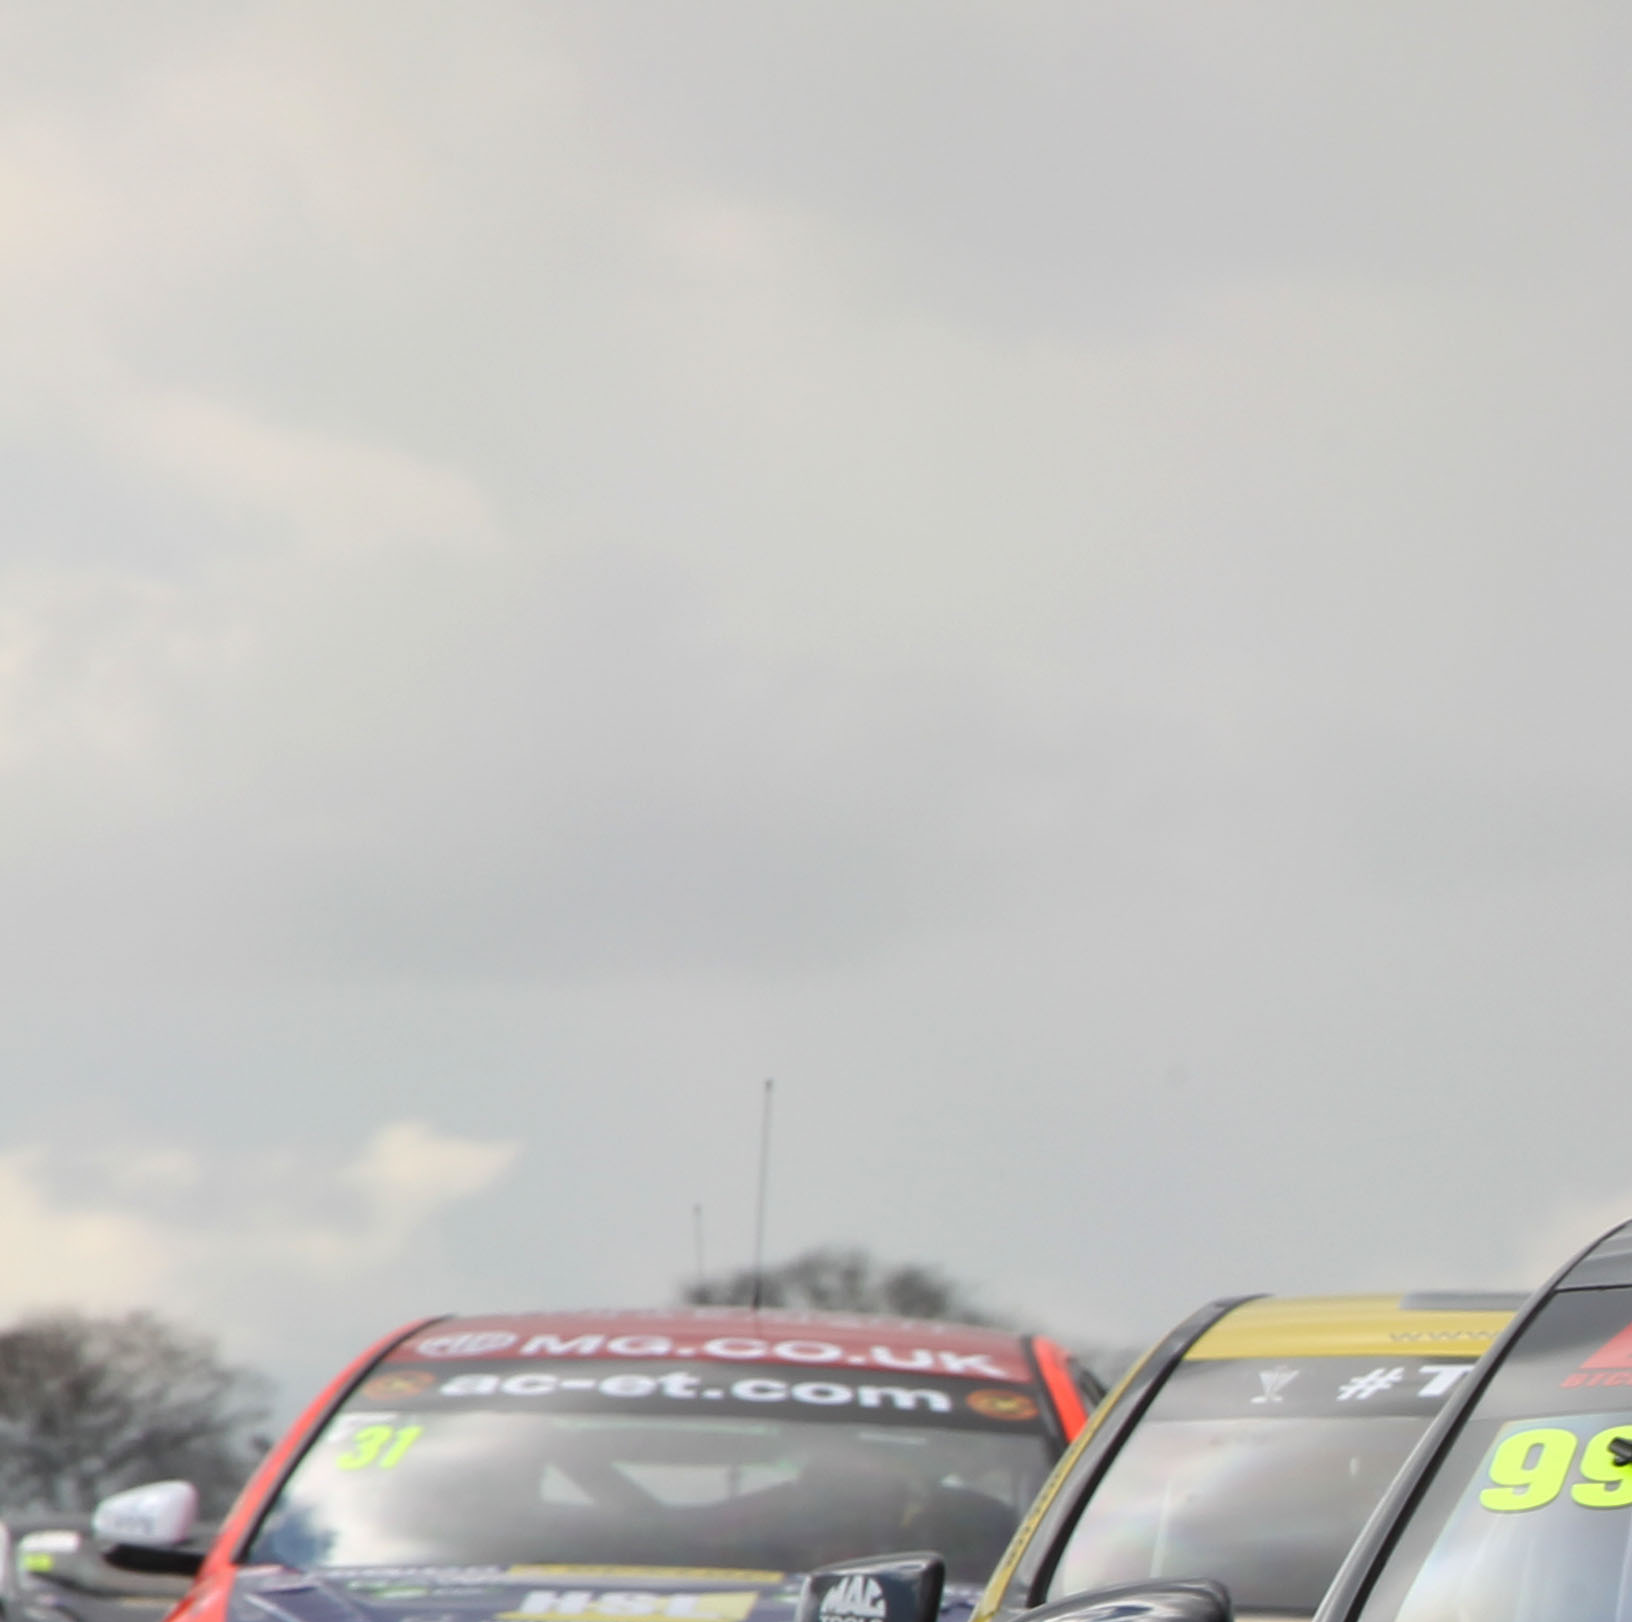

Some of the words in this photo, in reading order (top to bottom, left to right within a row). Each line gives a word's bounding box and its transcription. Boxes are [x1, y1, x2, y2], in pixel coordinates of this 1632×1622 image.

[438, 1371, 952, 1413] ac-et.com
[336, 1425, 424, 1472] 31
[820, 1574, 887, 1616] MAC
